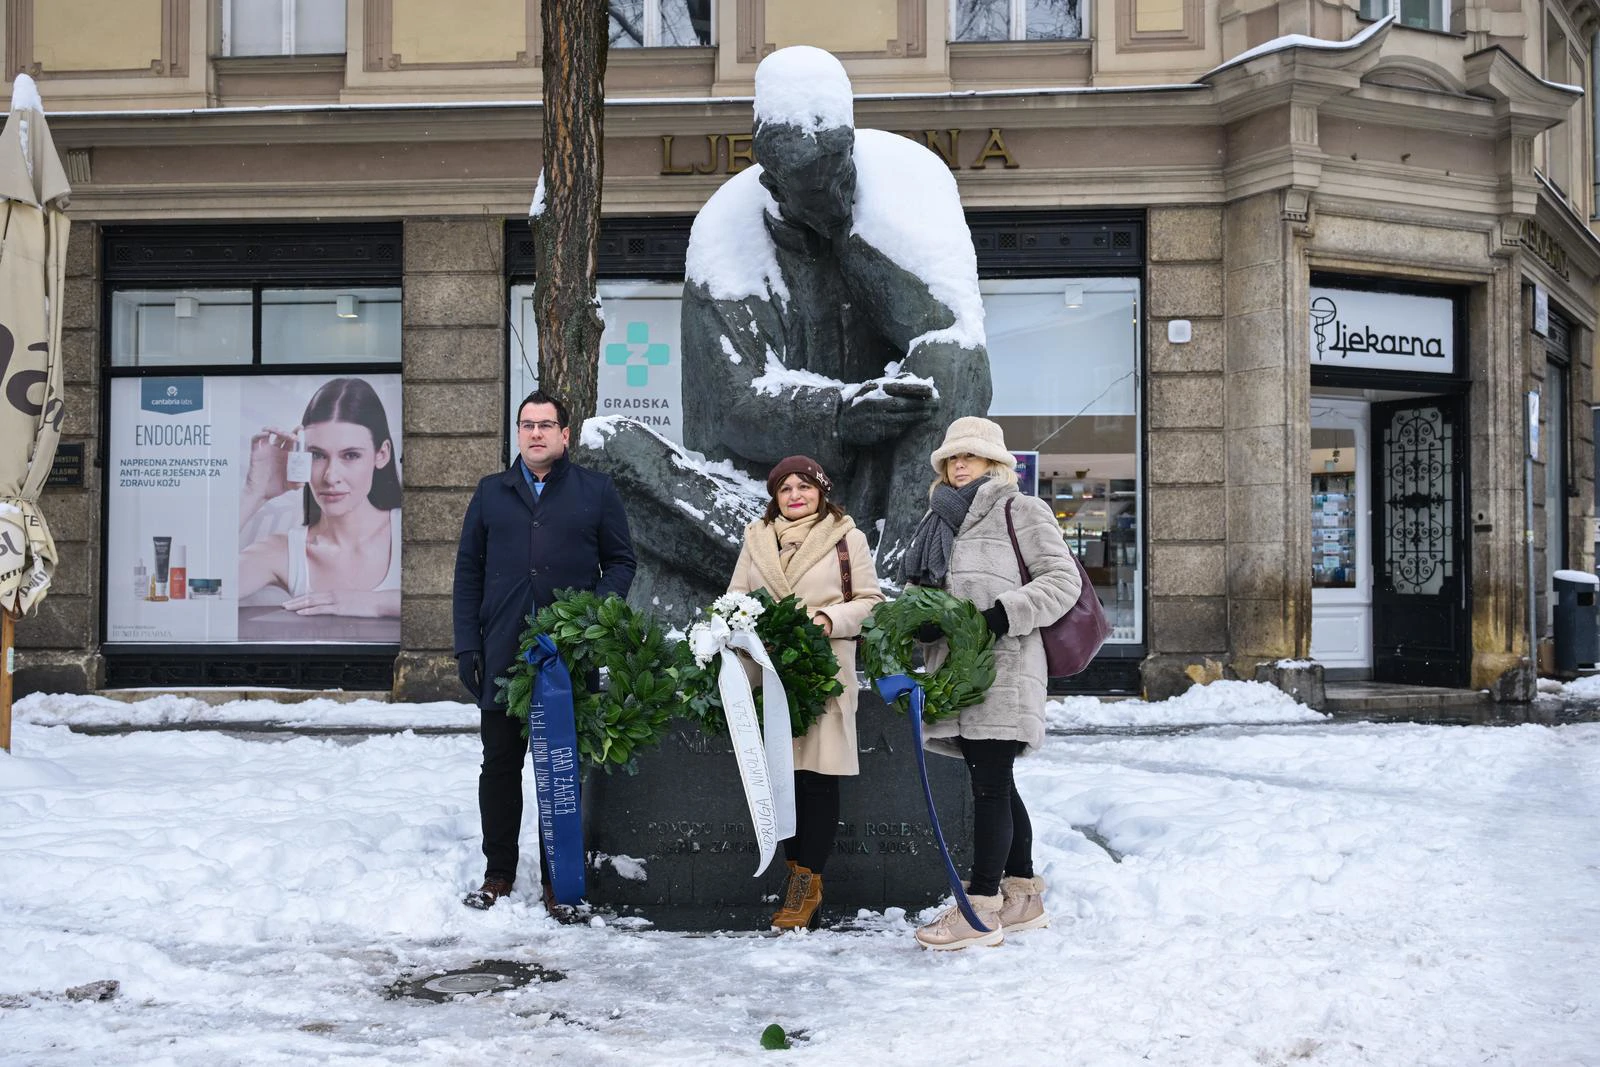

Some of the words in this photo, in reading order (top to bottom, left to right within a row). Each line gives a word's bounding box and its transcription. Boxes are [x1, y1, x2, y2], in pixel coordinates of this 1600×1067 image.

[603, 398, 670, 409] GRADSKA
[135, 424, 212, 446] ENDOCARE
[119, 458, 168, 467] NAPREDNA
[168, 458, 228, 467] ZNANSTVENA
[119, 468, 161, 477] ANTI-AGE
[162, 467, 207, 477] RJEŠENJA
[208, 468, 221, 477] ZA
[119, 478, 156, 487] ZDRAVU
[156, 477, 181, 487] KOŽU
[732, 699, 753, 736] TESLA
[550, 746, 574, 773] GRAD
[743, 747, 764, 787] NIKOLA
[553, 774, 577, 816] ZAGREB
[755, 798, 775, 851] UDRUGA
